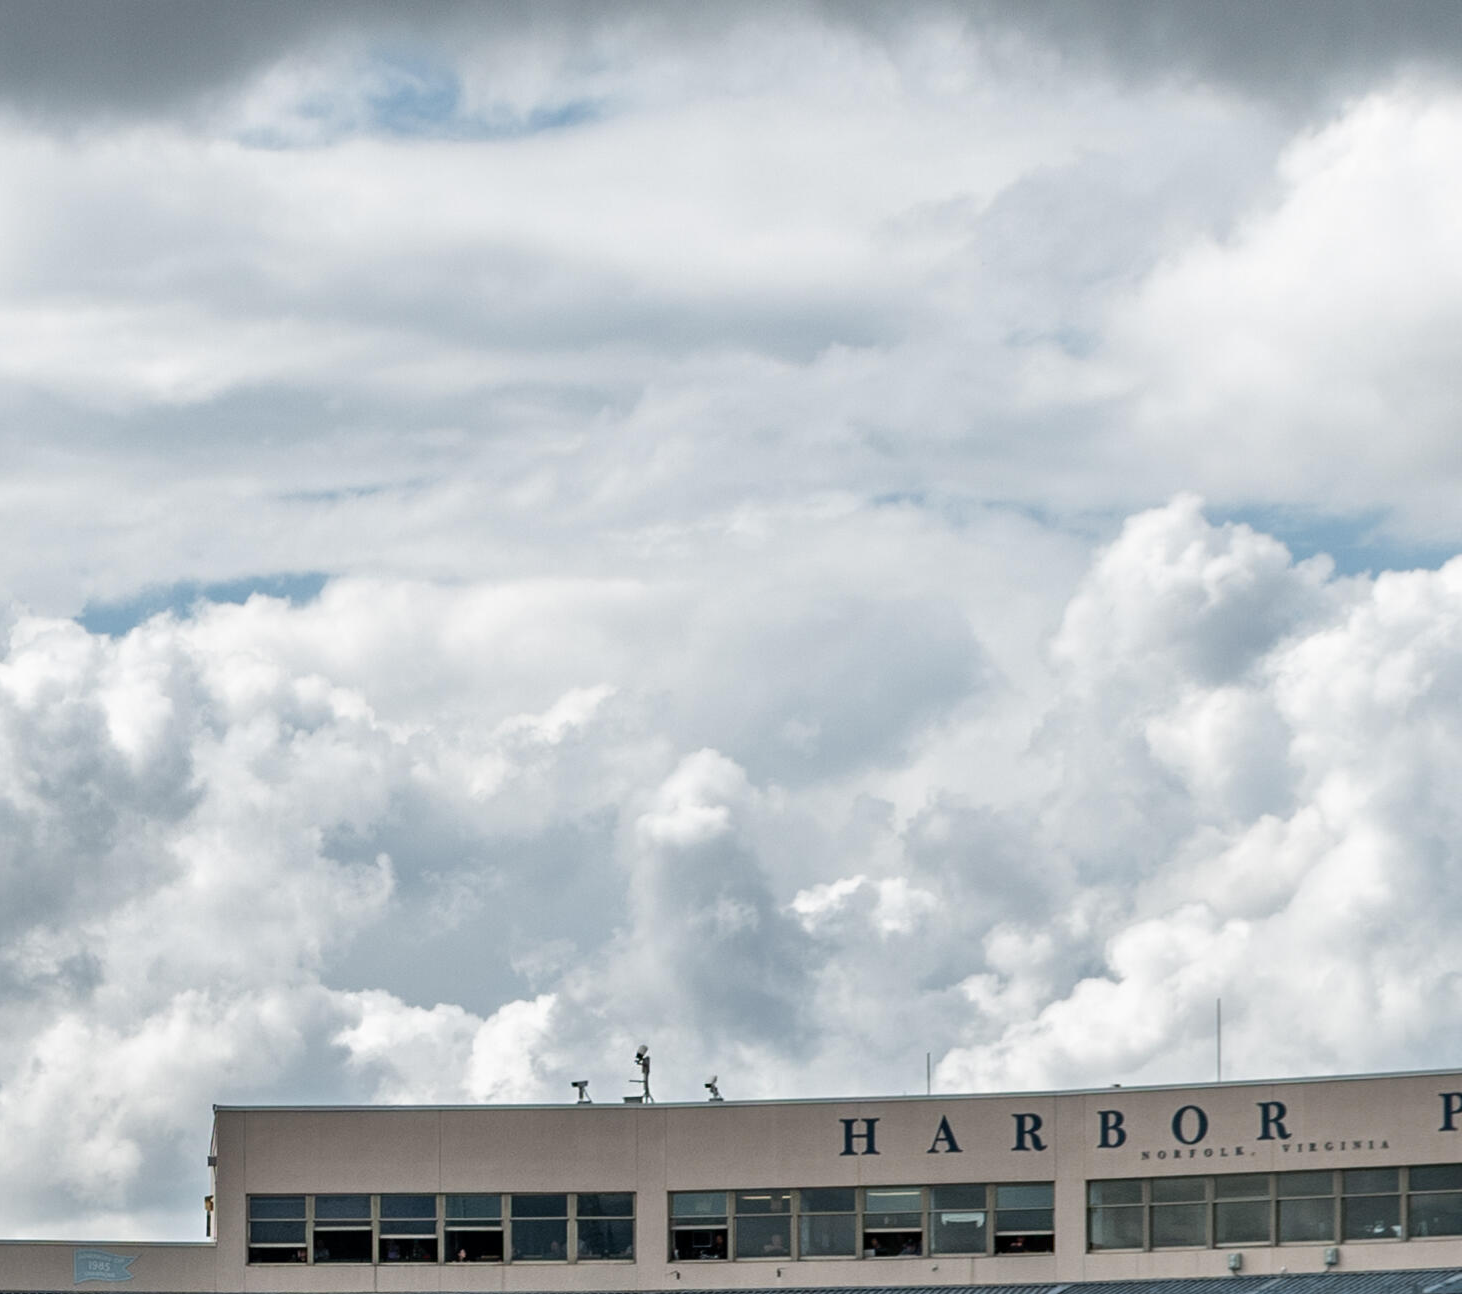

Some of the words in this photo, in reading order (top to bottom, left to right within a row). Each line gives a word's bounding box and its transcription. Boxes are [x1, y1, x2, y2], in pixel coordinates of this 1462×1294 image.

[839, 1101, 1292, 1157] HARBOR
[1282, 1140, 1391, 1153] VIRGINIA
[88, 1260, 111, 1272] 1985
